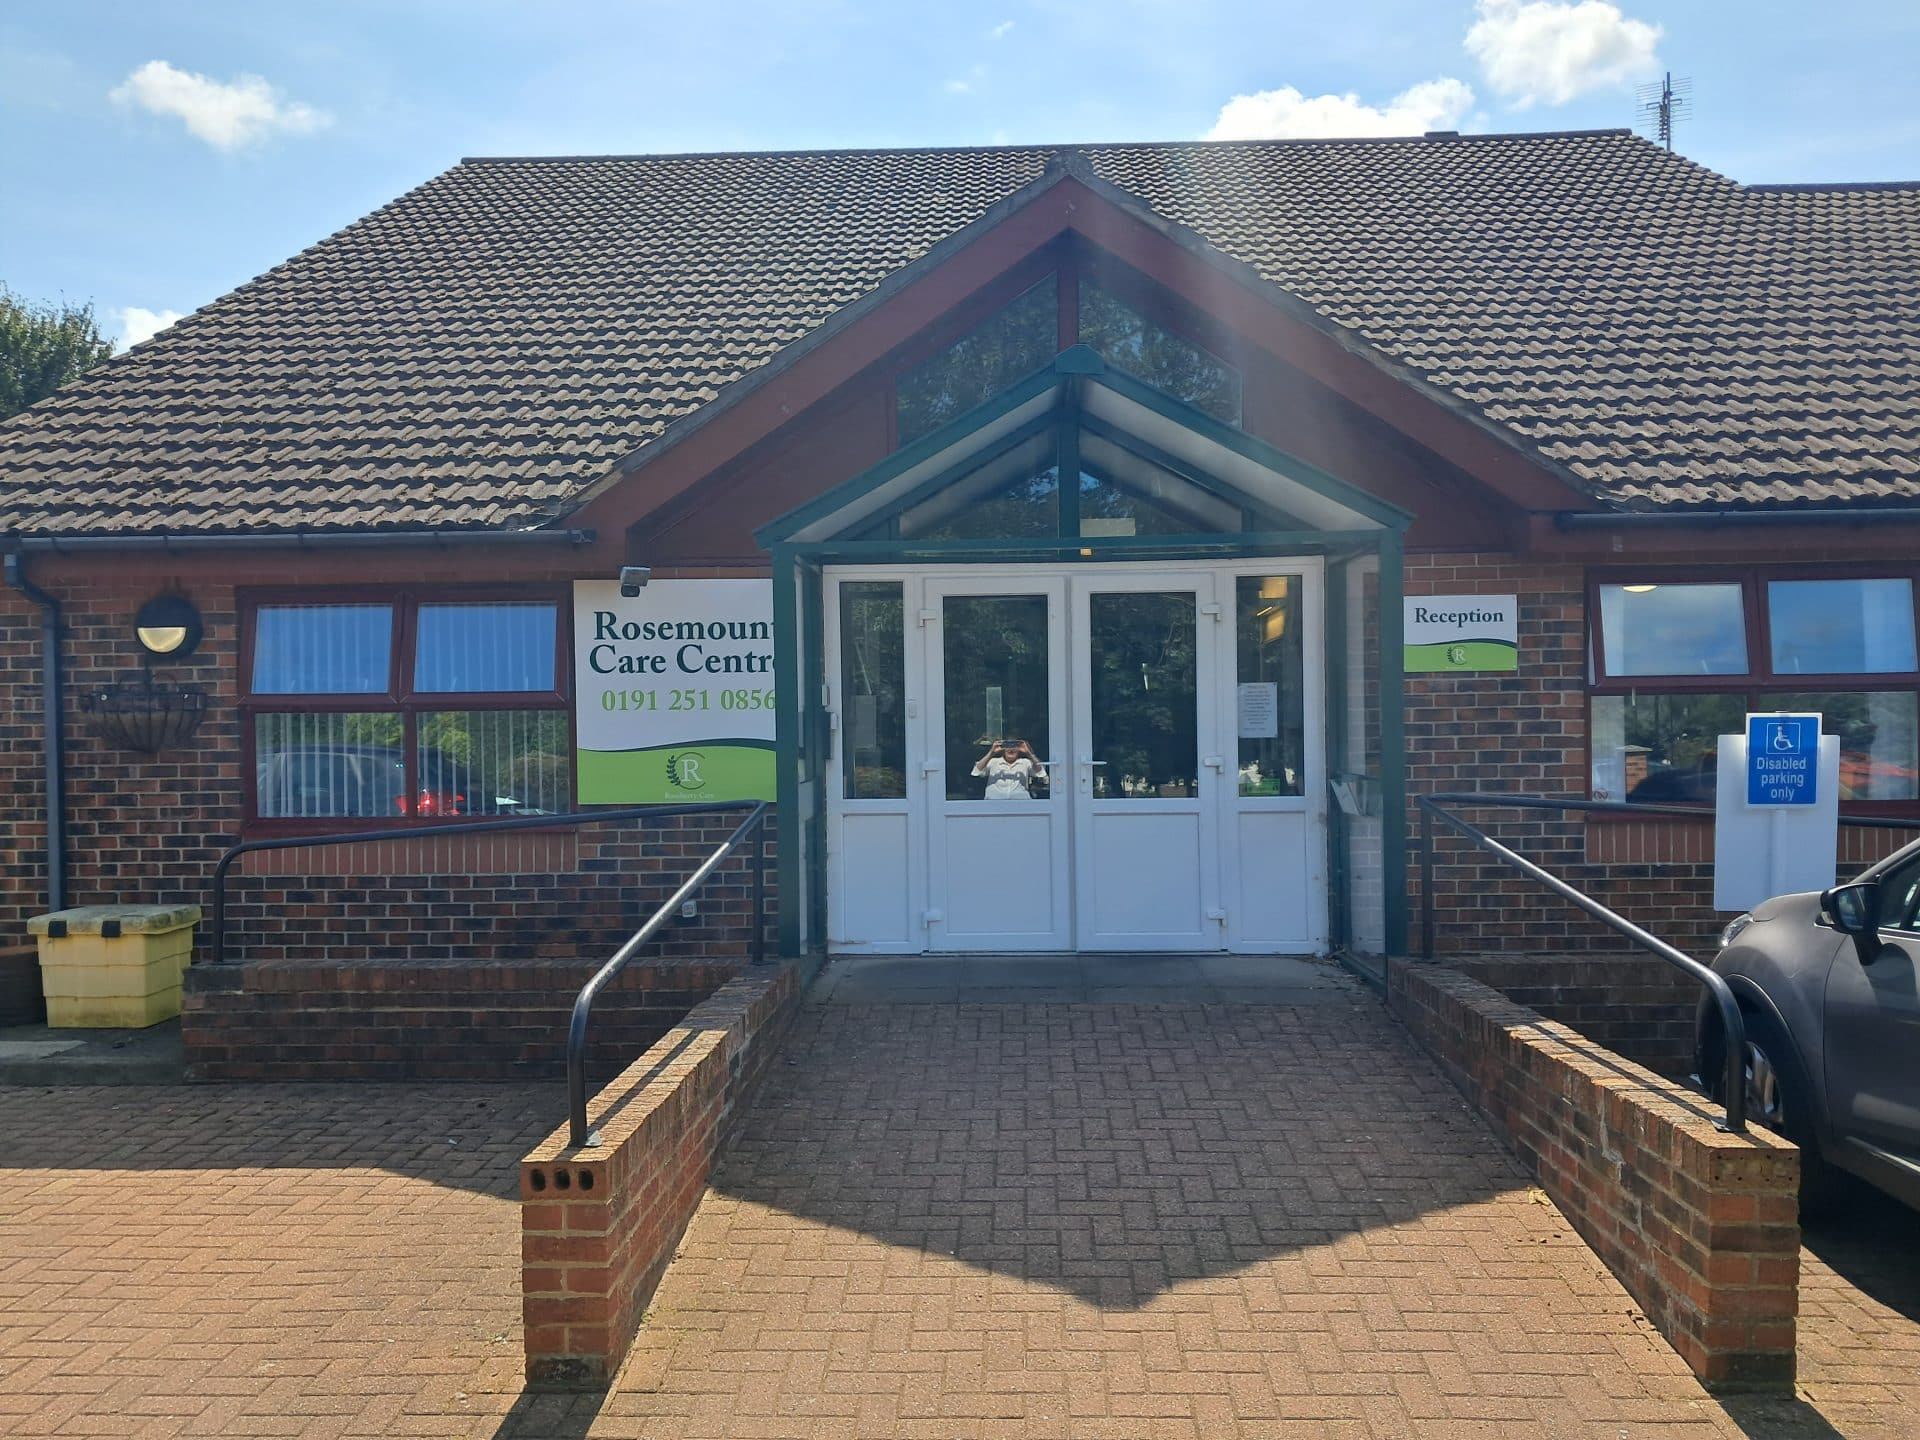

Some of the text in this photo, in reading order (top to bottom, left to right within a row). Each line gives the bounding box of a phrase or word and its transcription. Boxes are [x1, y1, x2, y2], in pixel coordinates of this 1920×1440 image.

[593, 611, 774, 640] Rosemoun
[1414, 607, 1504, 628] Reception
[589, 643, 775, 674] Care Centr
[601, 688, 776, 711] 0191 251 0856
[681, 759, 702, 782] R
[1756, 757, 1807, 770] Disabled
[1761, 772, 1804, 787] parking
[1770, 787, 1795, 801] only
